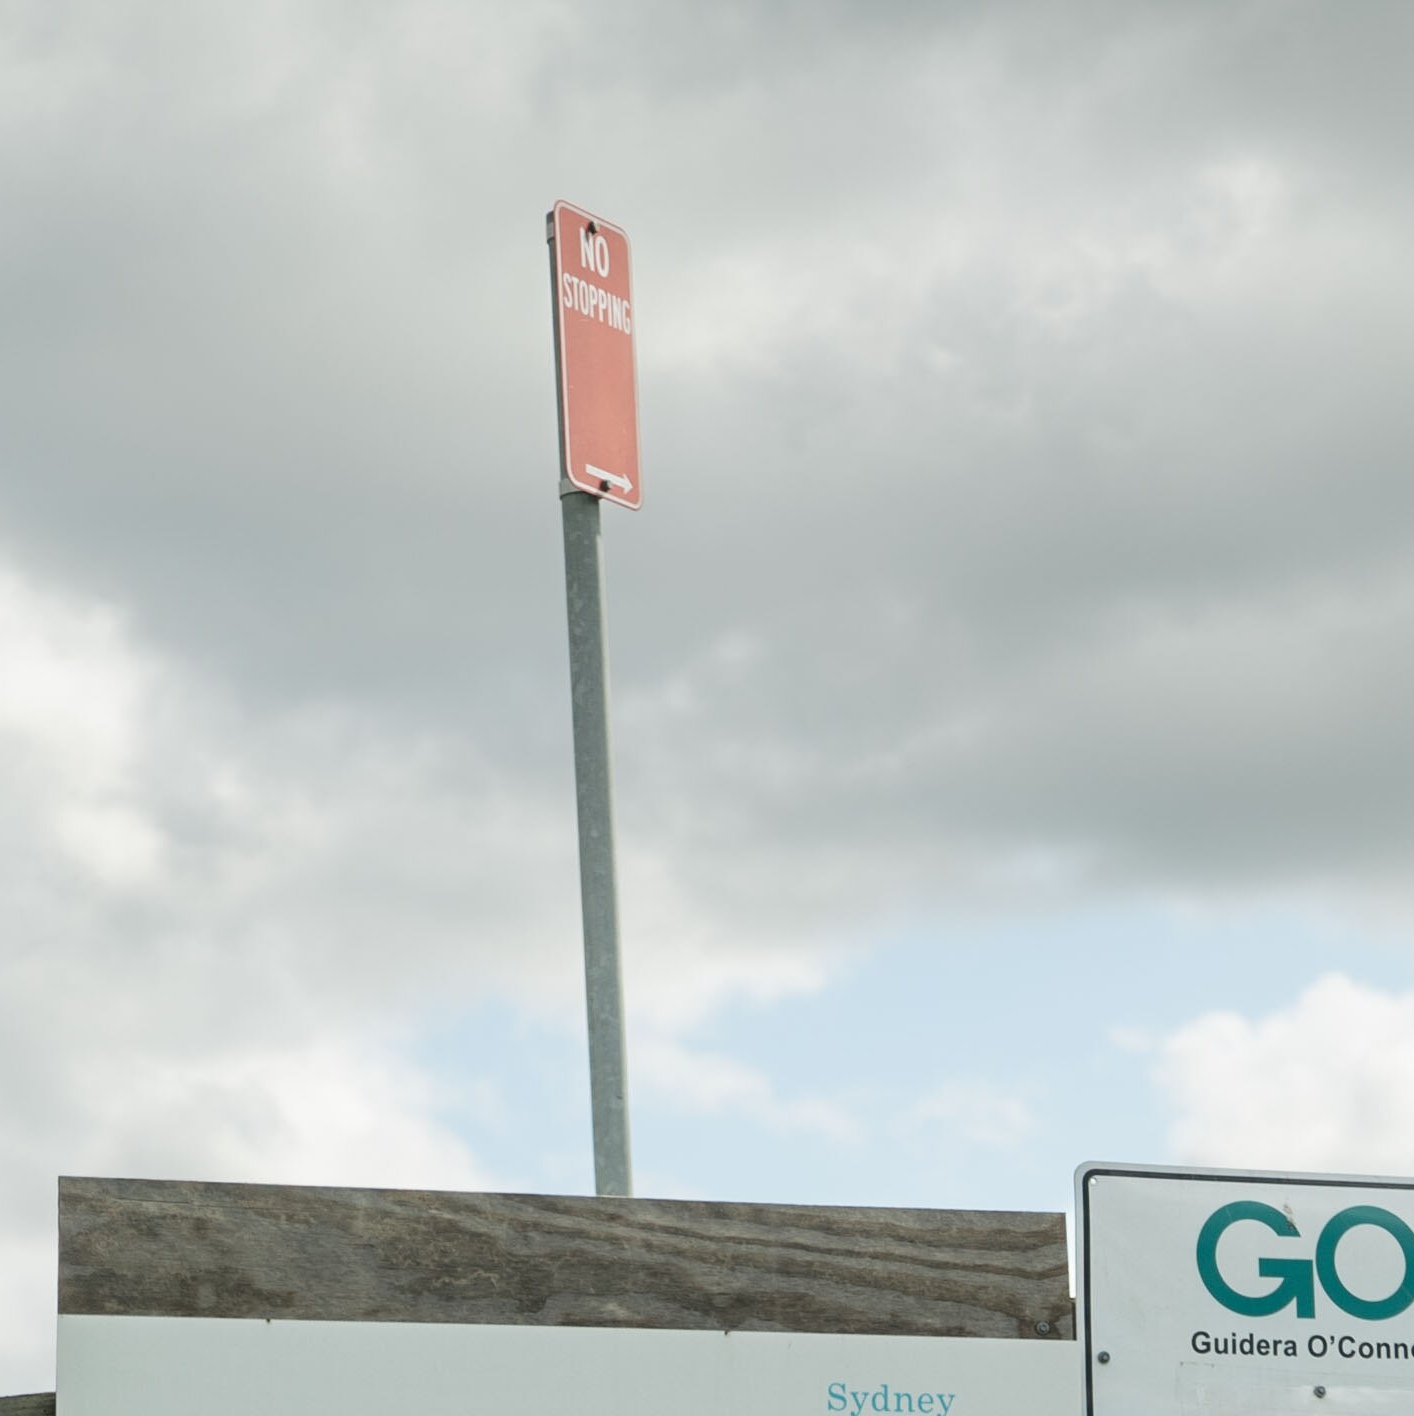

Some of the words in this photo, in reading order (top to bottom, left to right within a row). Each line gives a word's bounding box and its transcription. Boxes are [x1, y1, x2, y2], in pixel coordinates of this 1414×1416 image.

[580, 226, 610, 277] NO
[563, 273, 631, 335] STOPPING
[1191, 1330, 1298, 1357] Guidera
